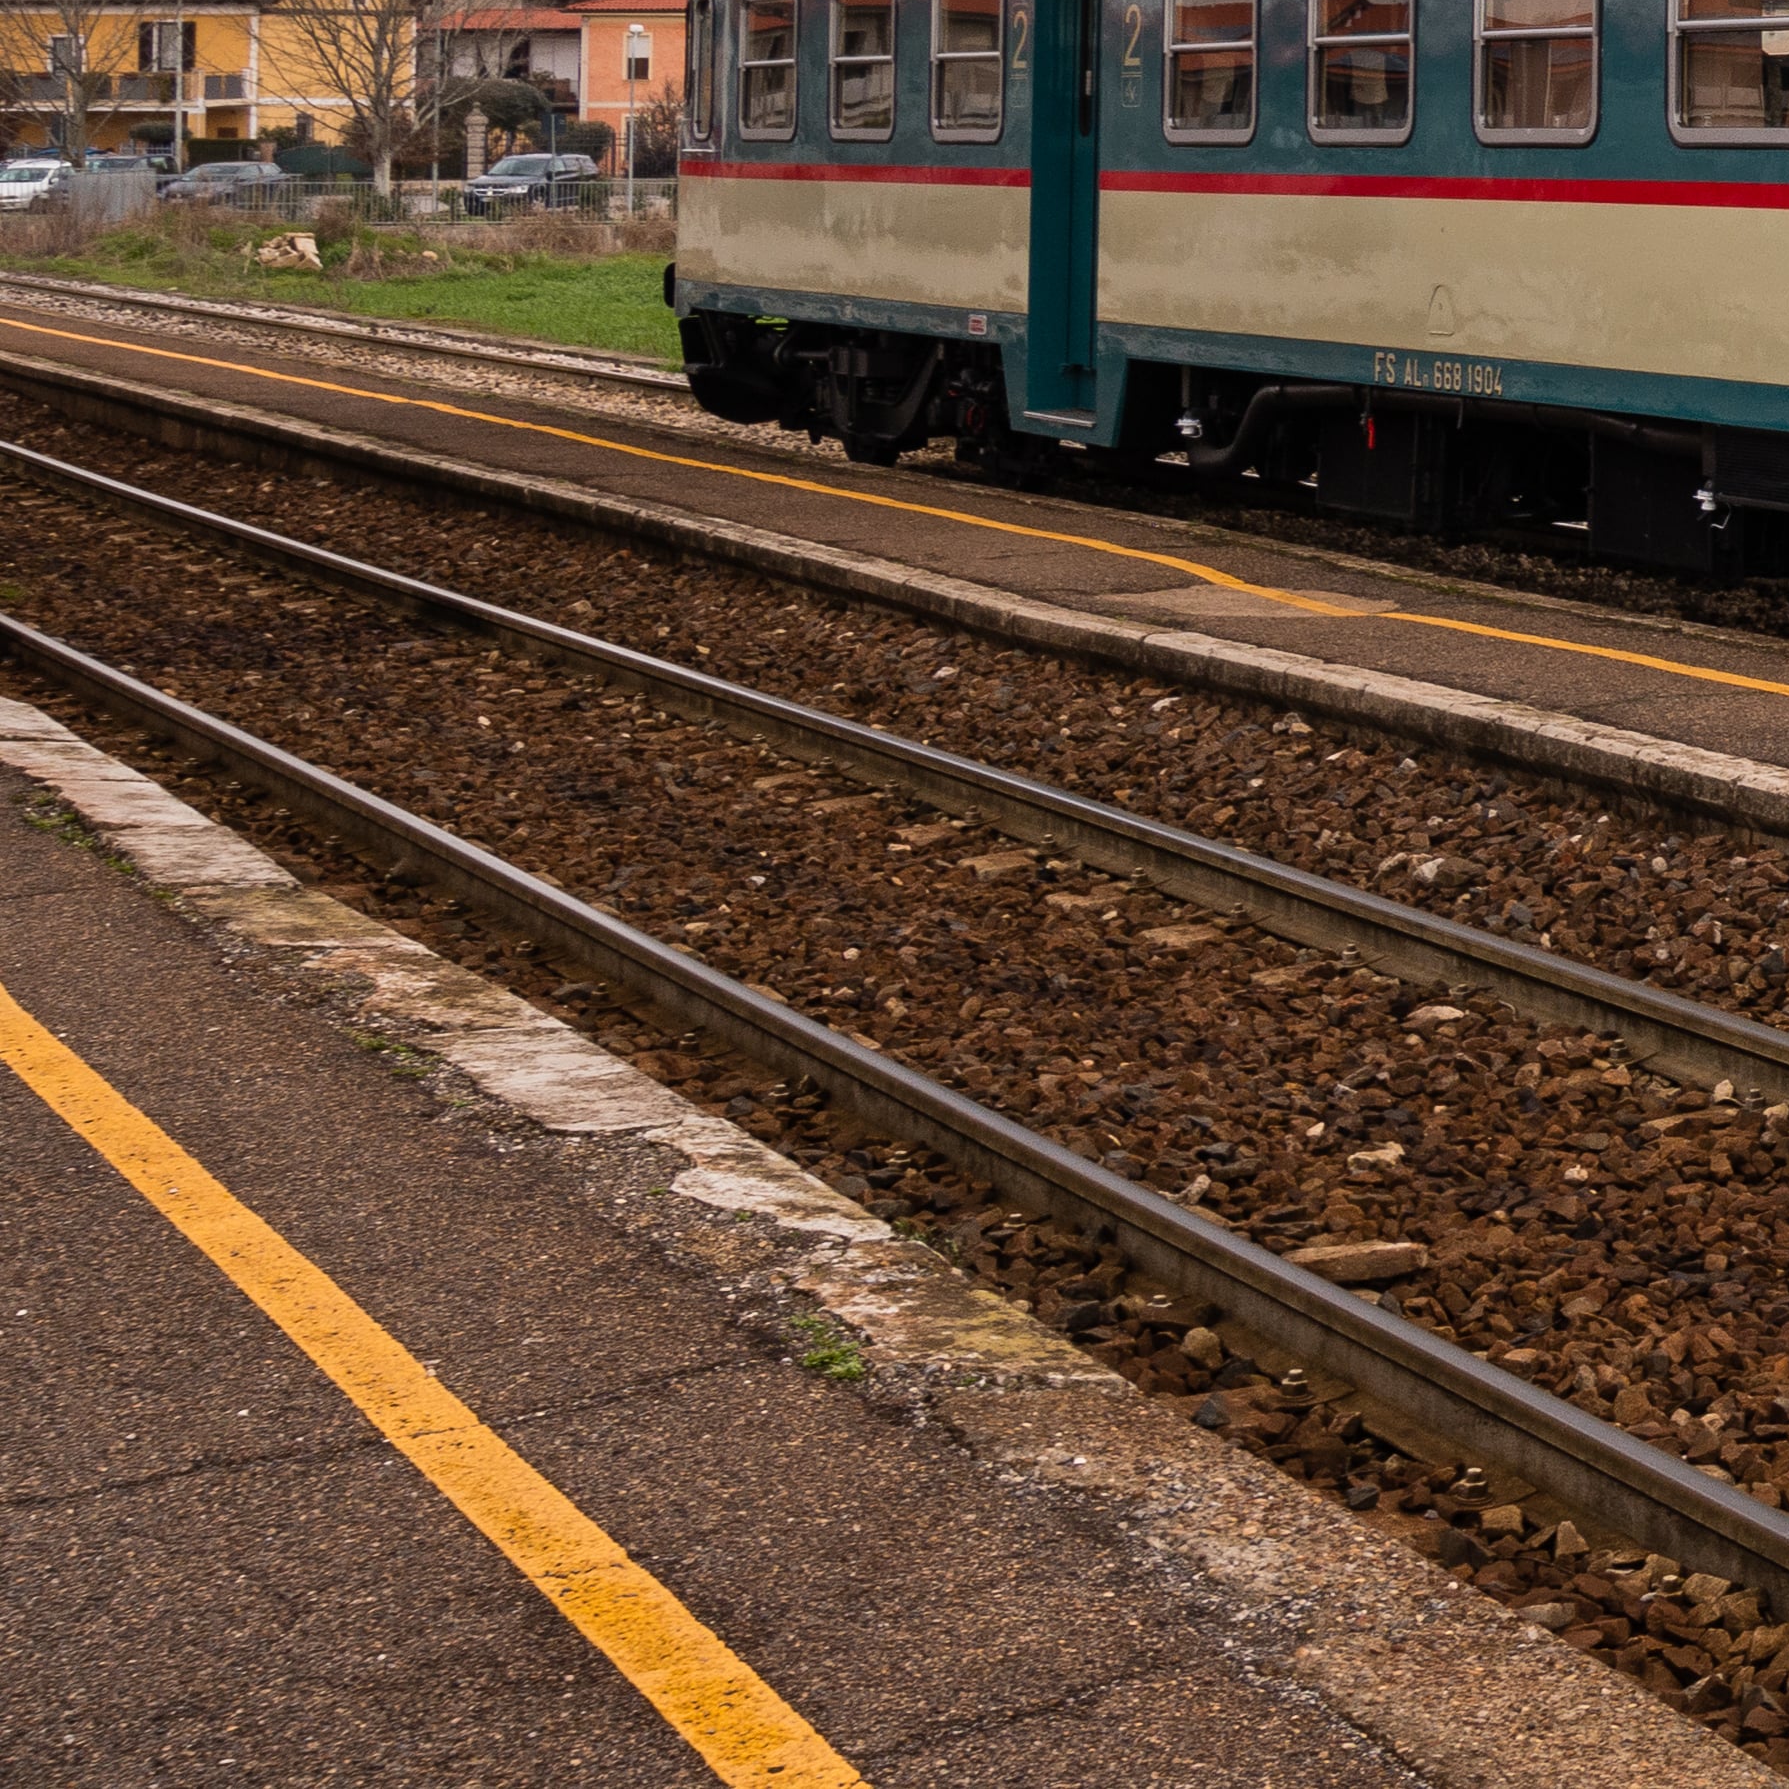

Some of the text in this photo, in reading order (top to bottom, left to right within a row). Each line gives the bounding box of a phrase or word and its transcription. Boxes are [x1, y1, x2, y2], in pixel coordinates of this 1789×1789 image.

[1012, 10, 1027, 69] 2
[1124, 3, 1141, 66] 2
[1374, 351, 1397, 384] FS
[1433, 360, 1462, 391] 668
[1467, 364, 1503, 396] 1904
